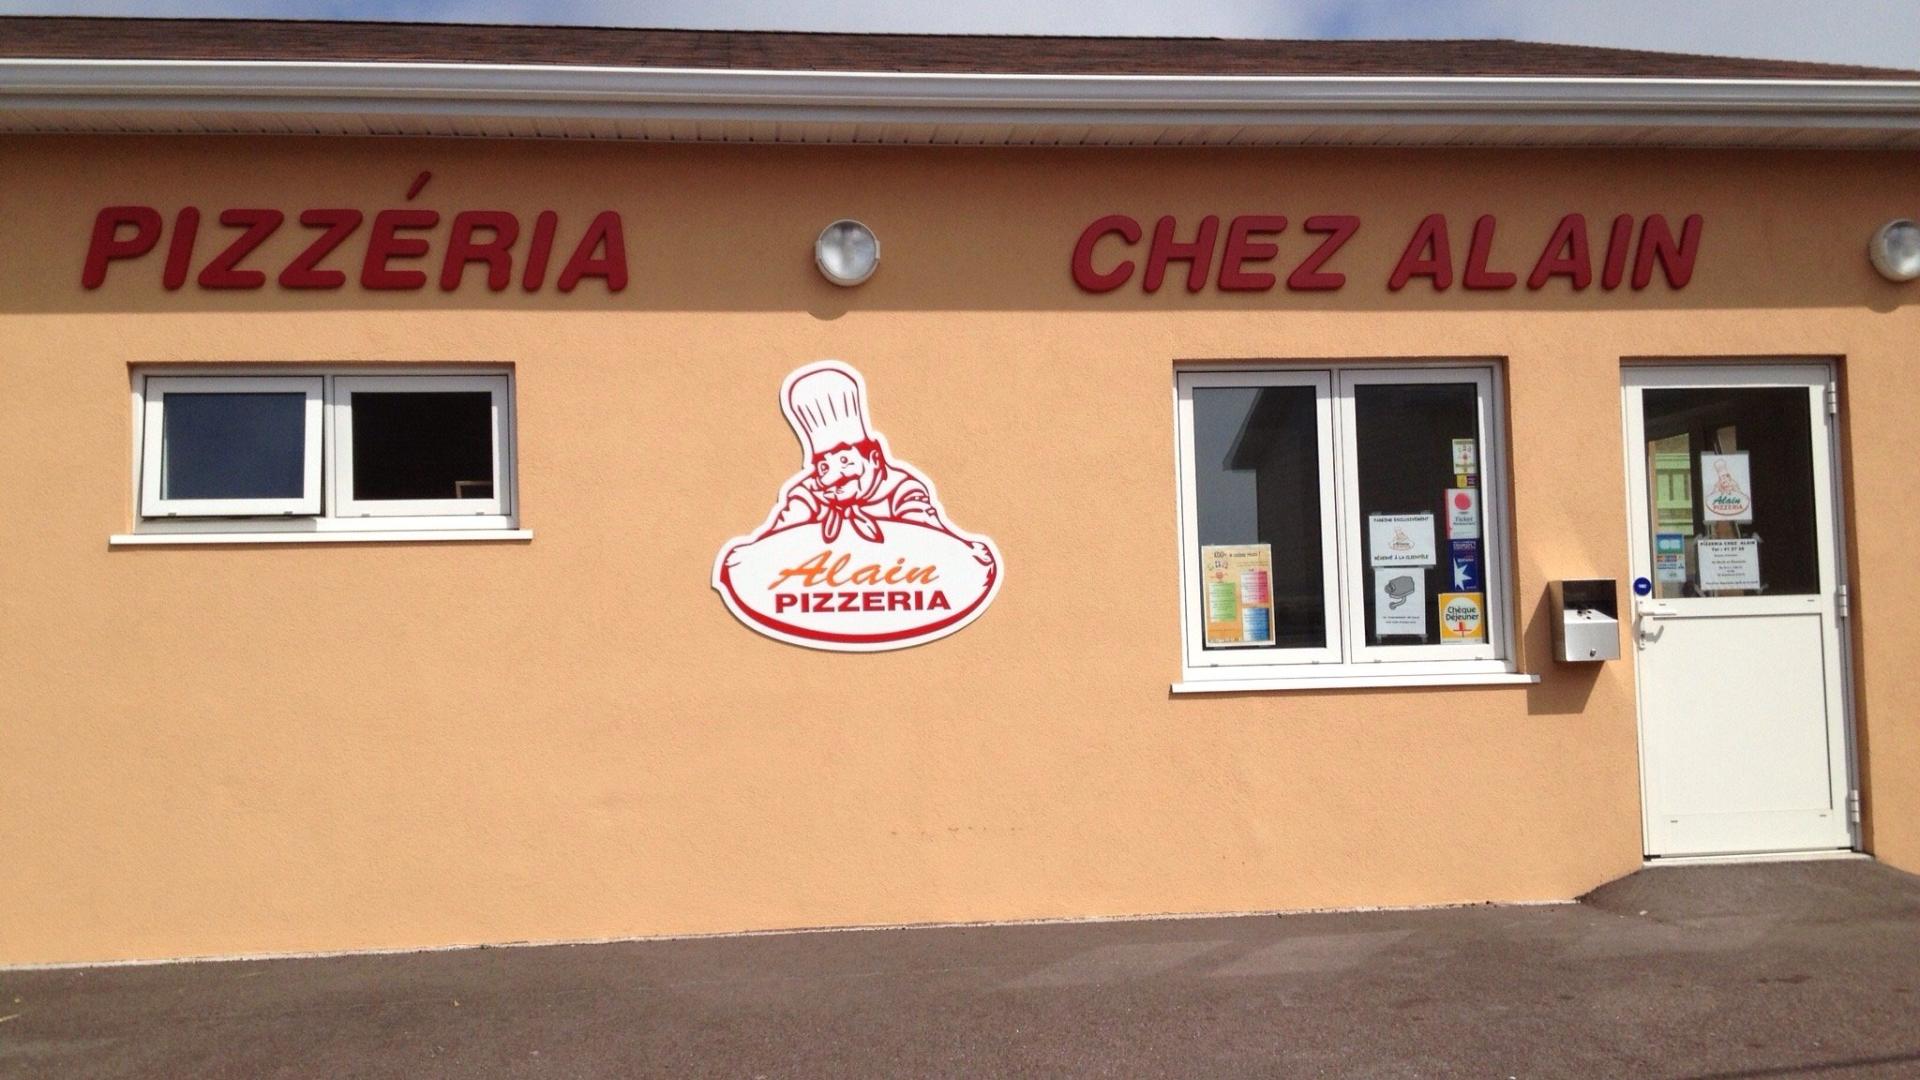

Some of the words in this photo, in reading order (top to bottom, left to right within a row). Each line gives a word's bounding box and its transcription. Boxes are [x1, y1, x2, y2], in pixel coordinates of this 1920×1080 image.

[82, 170, 628, 292] PIZZÉRIA
[1071, 214, 1361, 293] CHEZ
[1387, 213, 1703, 292] ALAIN
[767, 550, 940, 590] Alain
[775, 590, 951, 613] PIZZERIA
[1447, 606, 1477, 616] Chèque
[1445, 613, 1480, 622] Déjeuner
